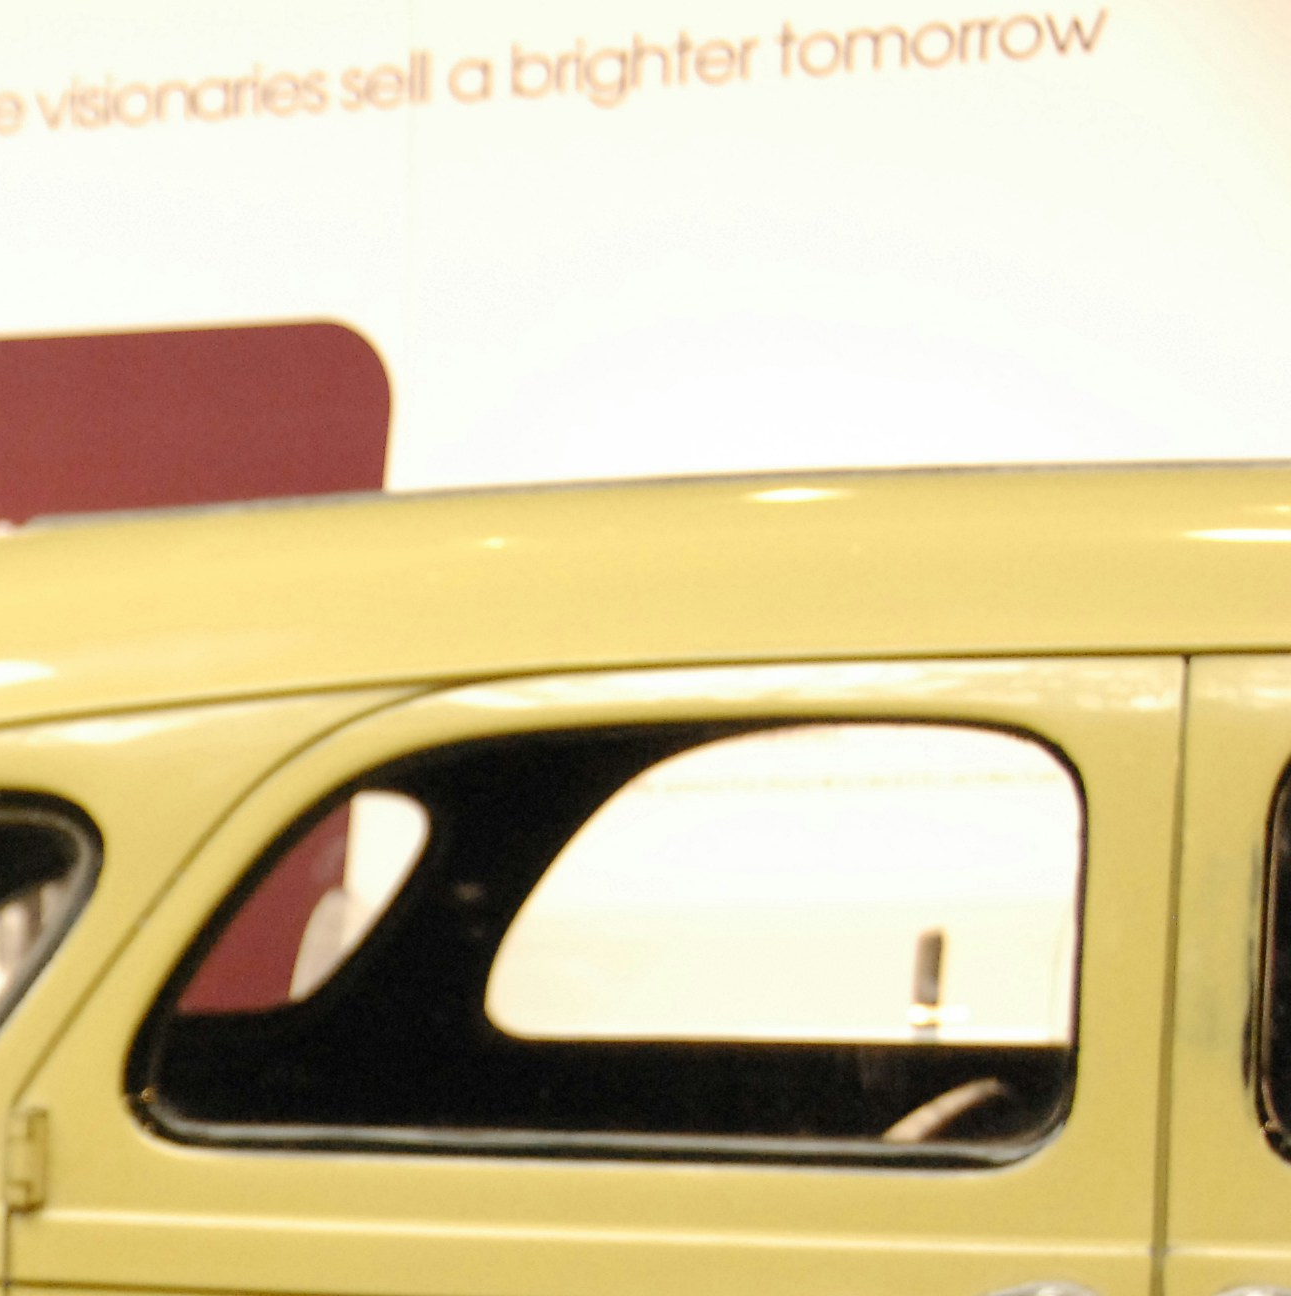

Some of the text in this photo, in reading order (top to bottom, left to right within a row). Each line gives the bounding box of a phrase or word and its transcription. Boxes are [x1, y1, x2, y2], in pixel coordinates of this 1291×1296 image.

[36, 66, 330, 131] visionaries
[340, 48, 432, 112] sell
[447, 58, 494, 103] a
[510, 30, 759, 109] brighter
[776, 7, 1109, 78] tomorrow
